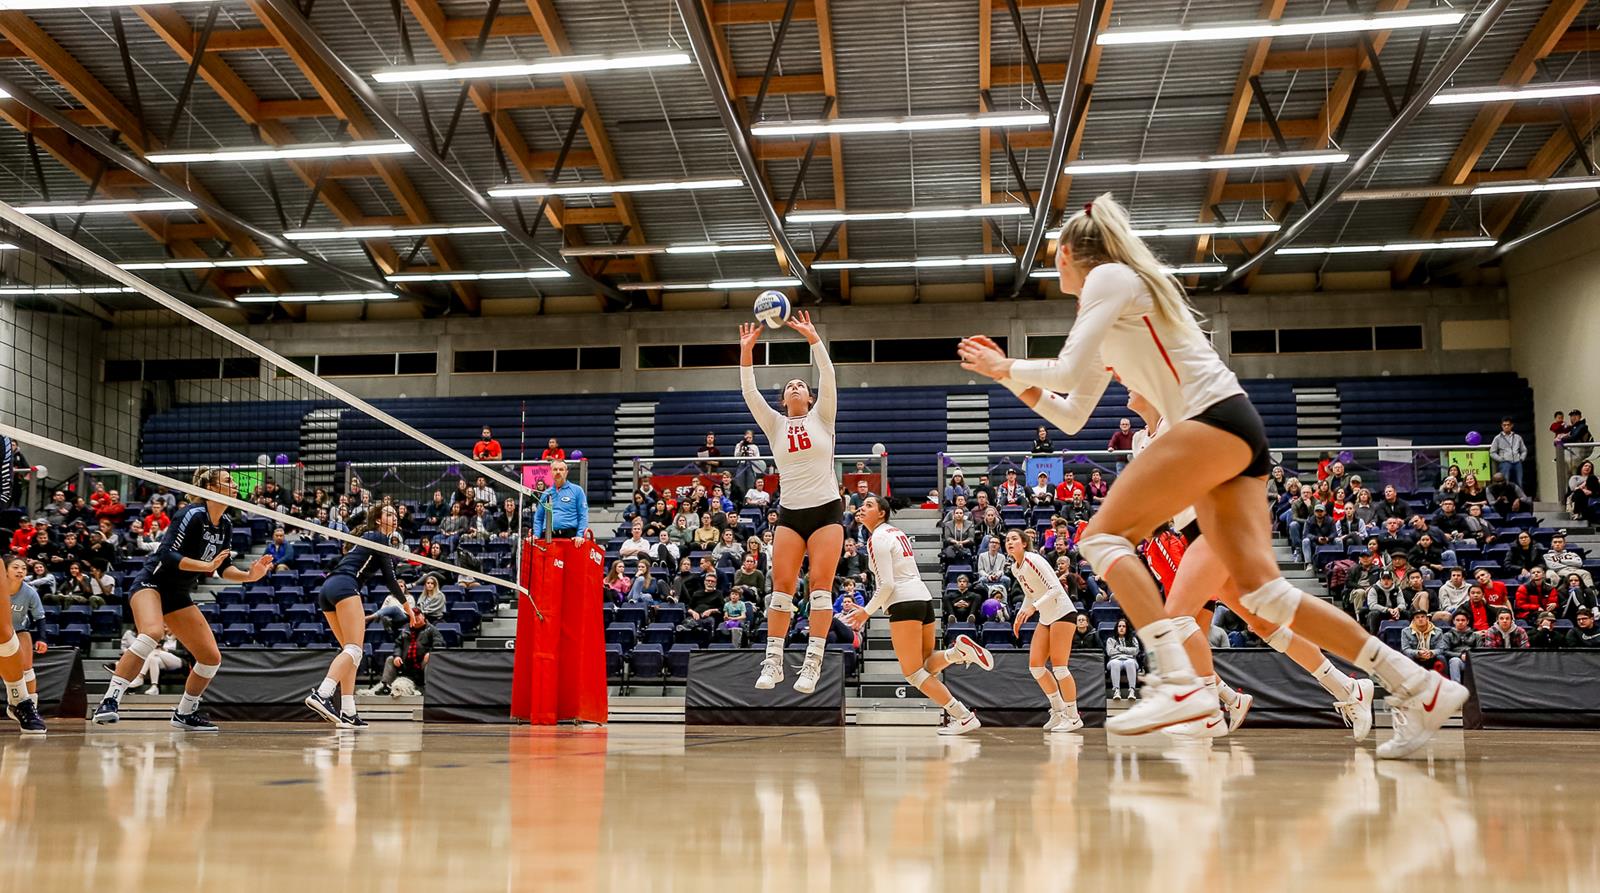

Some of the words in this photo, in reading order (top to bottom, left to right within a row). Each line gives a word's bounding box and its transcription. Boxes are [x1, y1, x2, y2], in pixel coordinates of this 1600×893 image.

[787, 432, 812, 453] 16
[896, 535, 914, 558] 10
[504, 639, 515, 650] G
[895, 686, 907, 699] G
